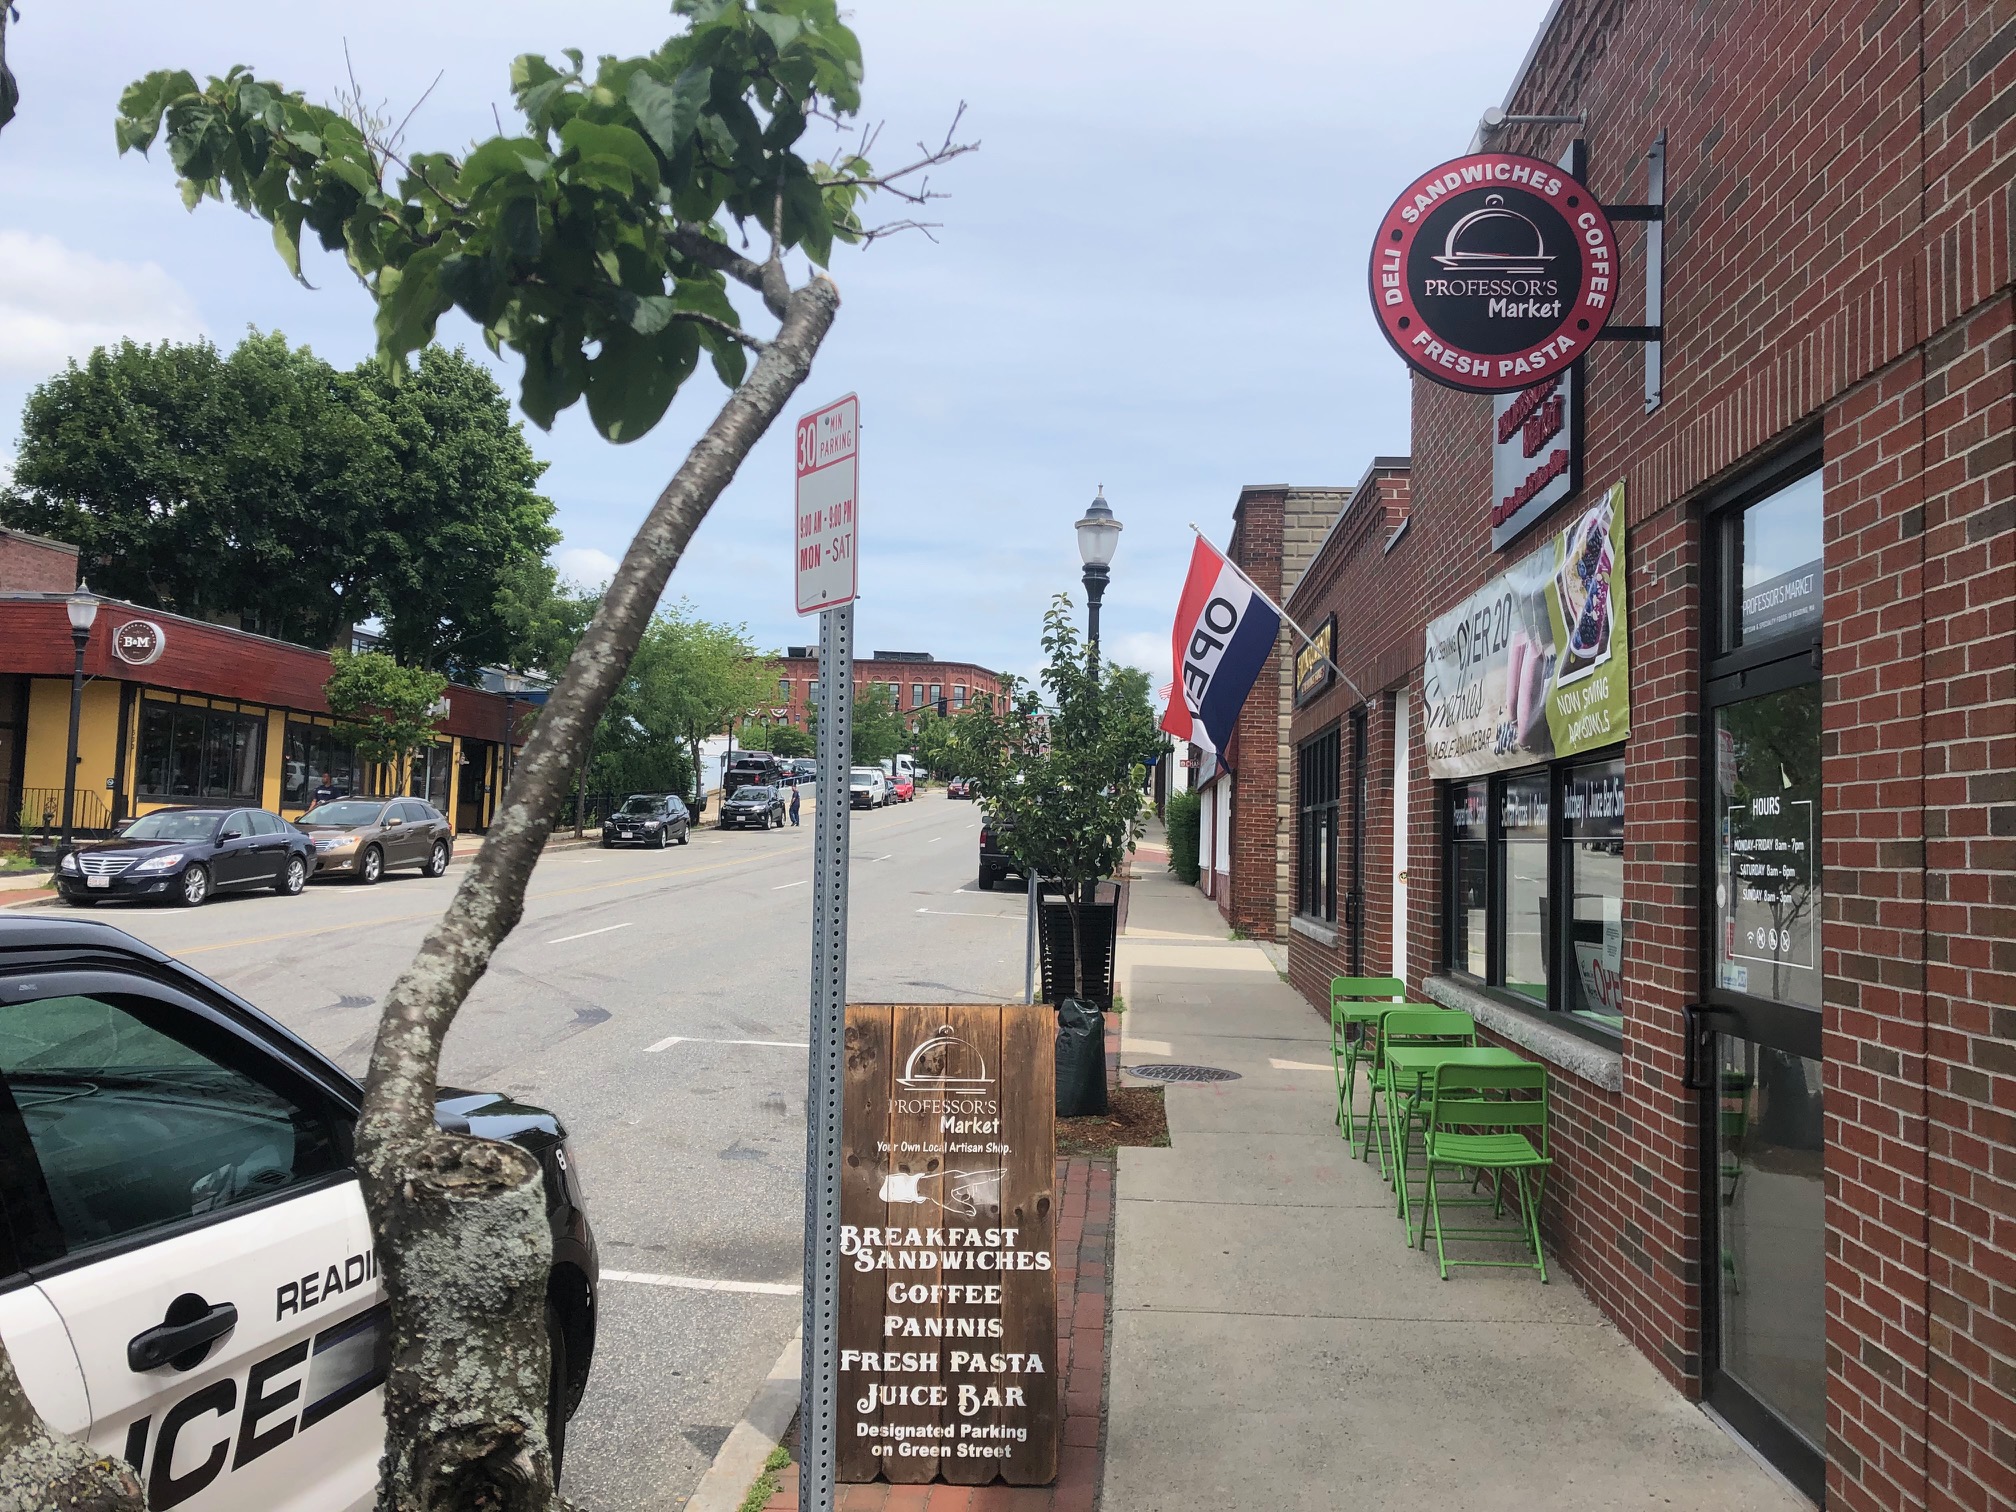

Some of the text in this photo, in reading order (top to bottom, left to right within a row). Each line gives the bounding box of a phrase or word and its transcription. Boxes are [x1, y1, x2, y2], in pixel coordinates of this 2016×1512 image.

[1401, 163, 1562, 223] SANDWICHES
[1577, 212, 1610, 309] COFFEE
[1382, 248, 1404, 306] DELI
[1425, 280, 1558, 296] PROFESSOR'S
[1488, 298, 1562, 318] Market
[1412, 330, 1576, 378] FRESH PASTA
[830, 412, 843, 433] MIN
[798, 423, 816, 471] 30
[820, 430, 852, 459] PARKING
[813, 510, 822, 534] AM
[843, 499, 852, 524] PM
[800, 543, 821, 572] MON
[832, 533, 851, 562] SAT
[1784, 574, 1815, 602] MARKET
[1493, 593, 1512, 655] 20
[1557, 690, 1581, 716] NOW
[1752, 796, 1780, 816] HOURS
[1734, 838, 1774, 851] MONDAY-FRIDAY
[1775, 838, 1787, 851] 8am
[1791, 837, 1804, 854] 7pm
[1740, 864, 1766, 876] SATURDAY
[1766, 864, 1778, 876] 8am
[1782, 864, 1796, 879] 6pm
[1742, 888, 1763, 901] SUNDAY
[1763, 889, 1775, 902] 8am
[888, 1099, 997, 1114] PROFESSOR'S
[940, 1116, 999, 1134] Market
[877, 1141, 1012, 1155] Your Own Local Artisan Shop.
[839, 1226, 1019, 1256] BREAKFAST
[854, 1249, 1052, 1272] SANDWICHES
[276, 1249, 378, 1322] READI
[887, 1282, 1003, 1305] COFFEE
[884, 1316, 1004, 1338] PANINIS
[840, 1350, 1046, 1373] FRESH PASTA
[856, 1384, 1027, 1416] JUICE BAR
[856, 1422, 1028, 1442] Designated Parking
[871, 1443, 1012, 1458] on Green Street
